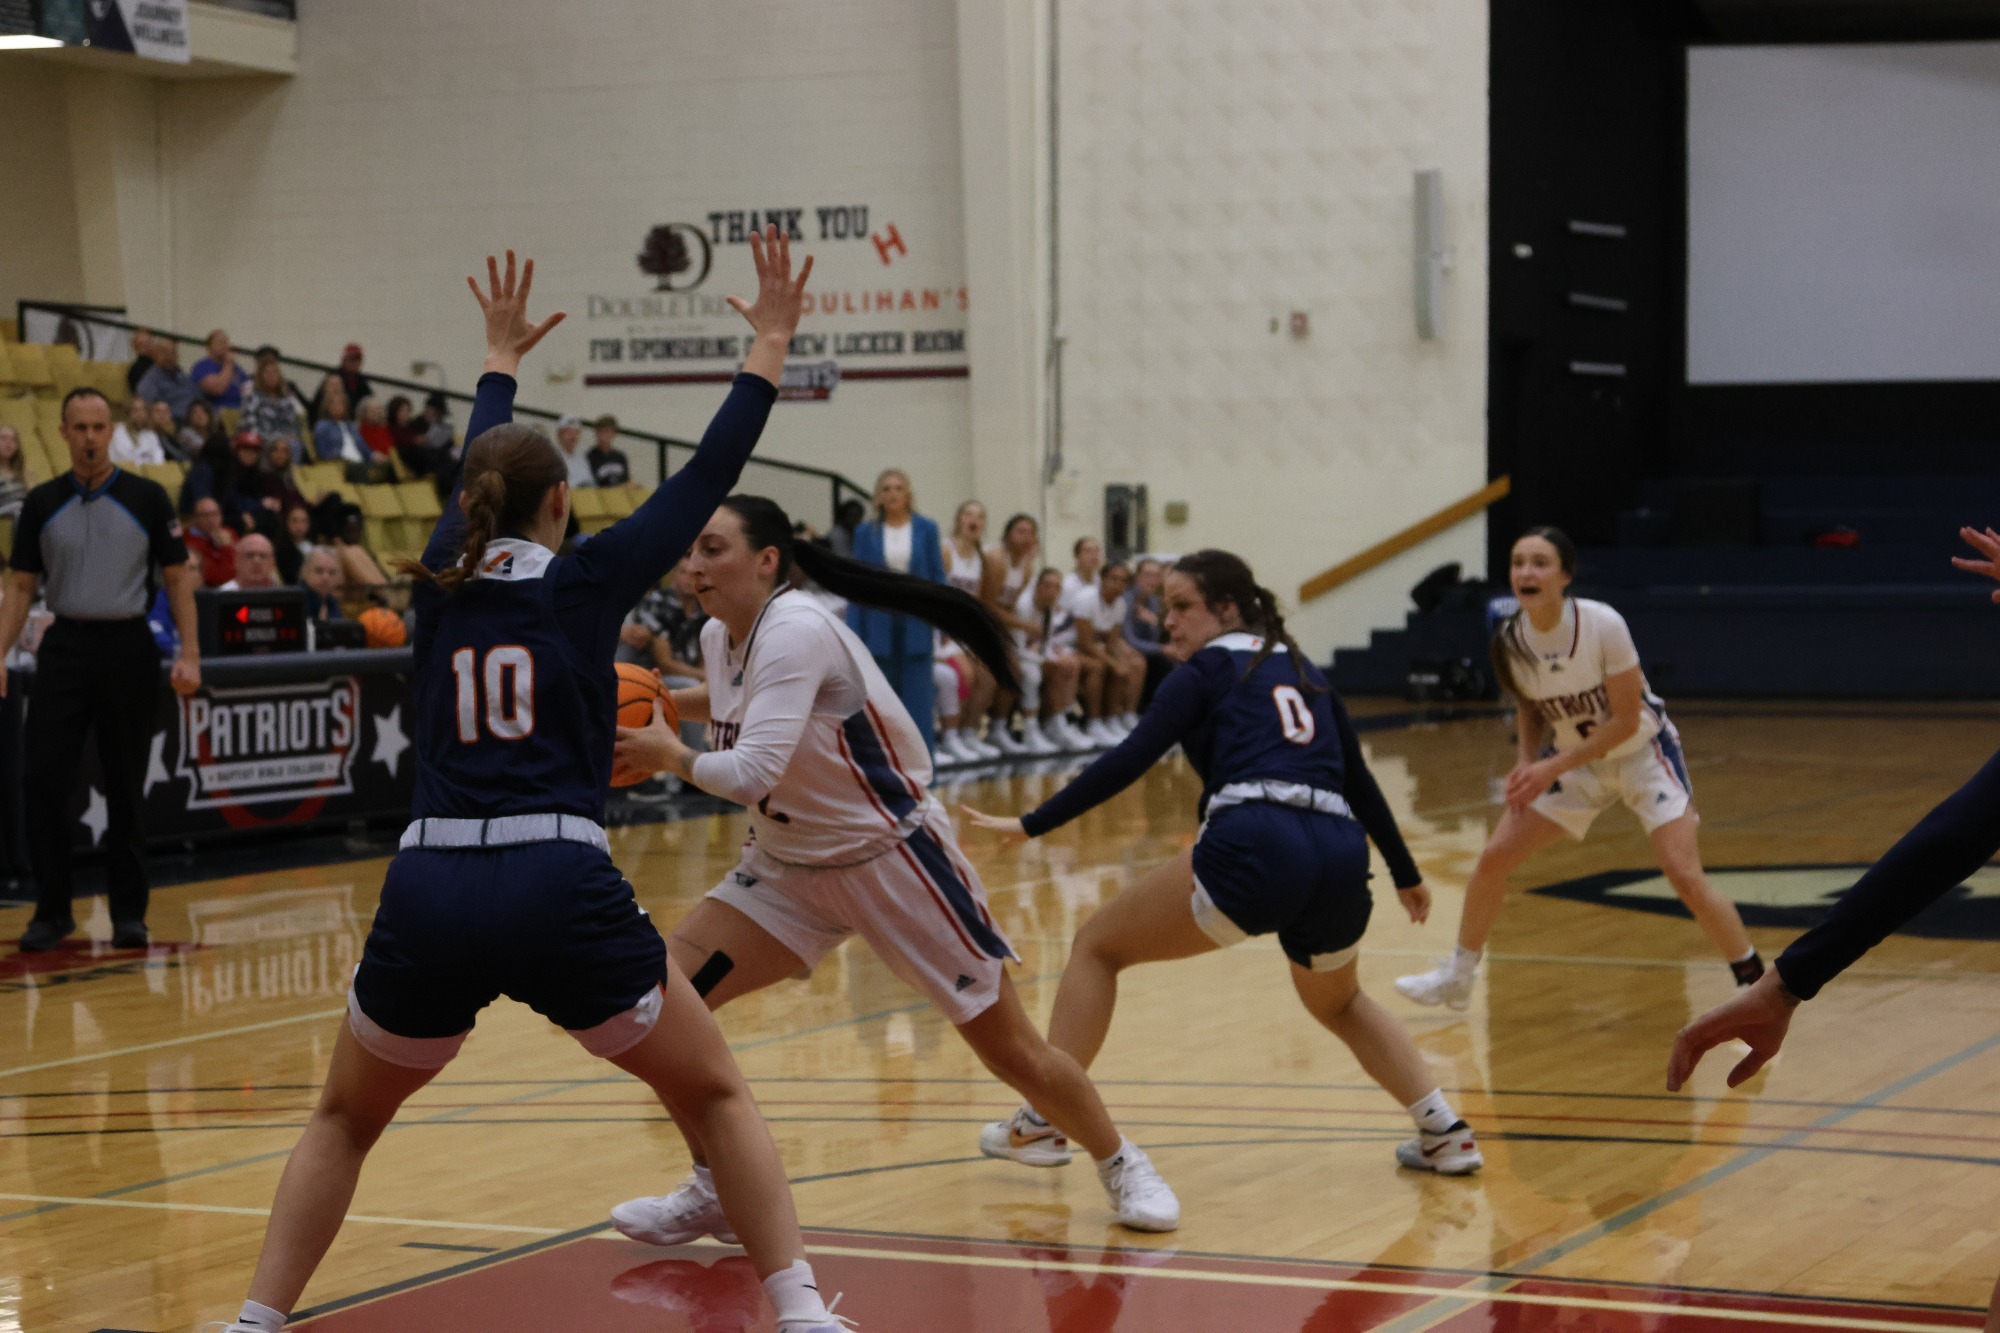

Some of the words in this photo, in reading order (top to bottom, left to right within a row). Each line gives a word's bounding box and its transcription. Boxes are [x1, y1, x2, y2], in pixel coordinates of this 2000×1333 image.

[707, 207, 804, 244] THANK
[815, 205, 869, 241] YOU
[799, 286, 969, 315] OULIHAN'S
[188, 687, 350, 760] PATRIOTS
[451, 644, 535, 744] 10
[1272, 684, 1315, 745] 0
